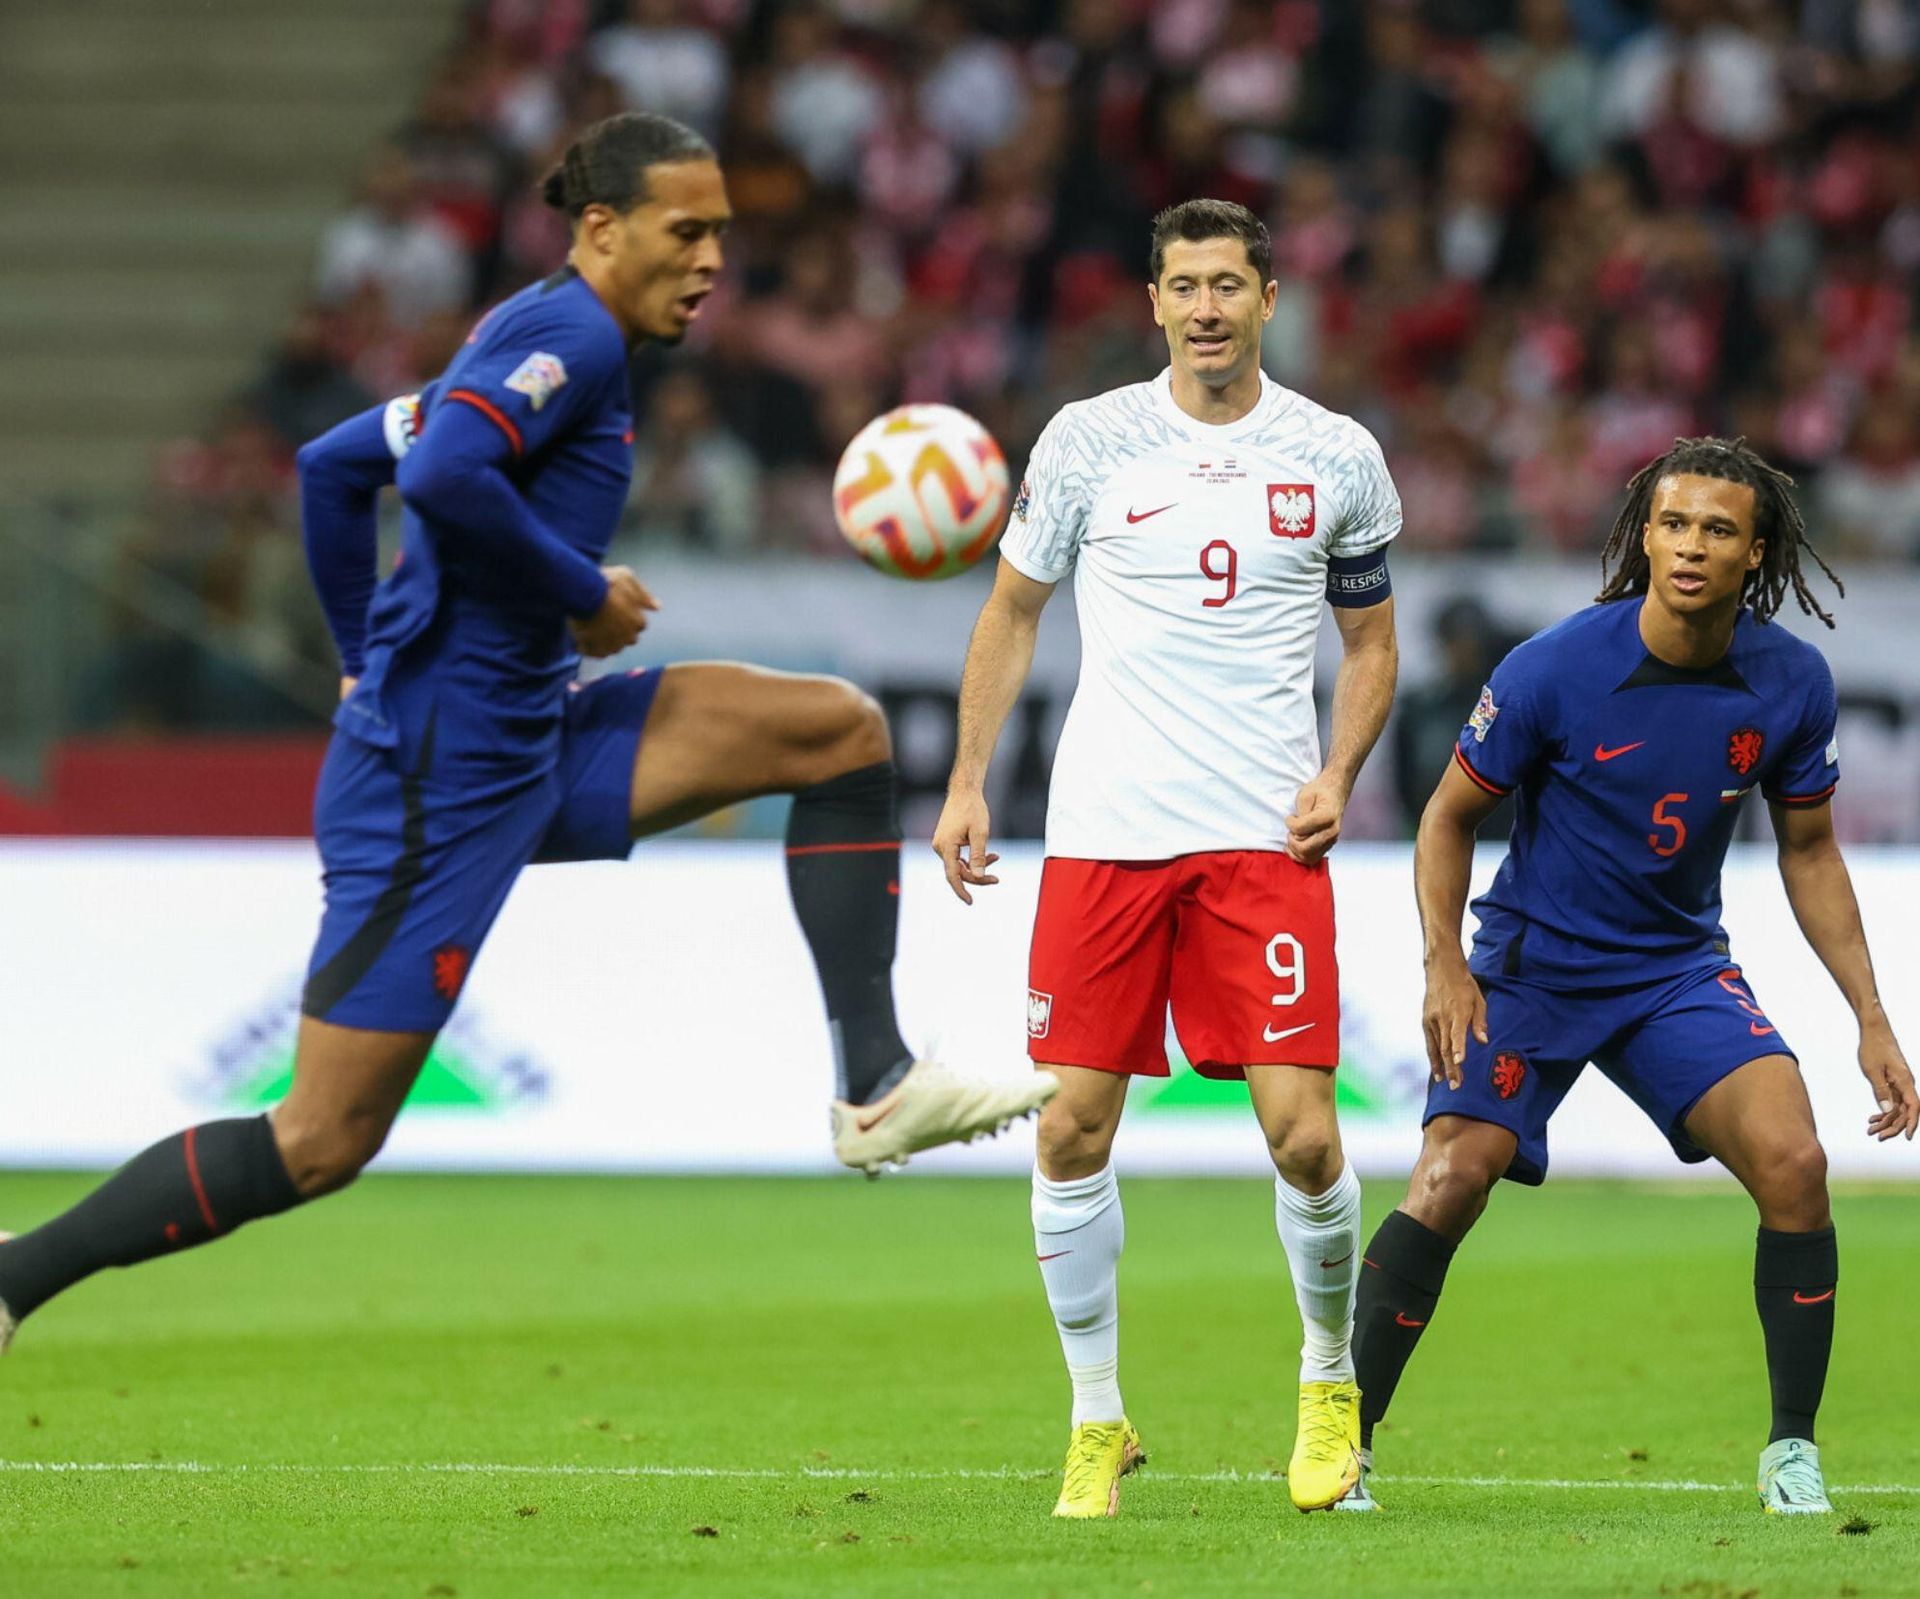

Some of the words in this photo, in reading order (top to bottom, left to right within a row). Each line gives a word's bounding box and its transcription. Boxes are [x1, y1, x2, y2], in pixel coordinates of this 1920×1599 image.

[1200, 540, 1237, 607] 9
[1341, 566, 1386, 589] RESPECT
[1648, 792, 1688, 857] 5
[1265, 933, 1305, 1006] 9
